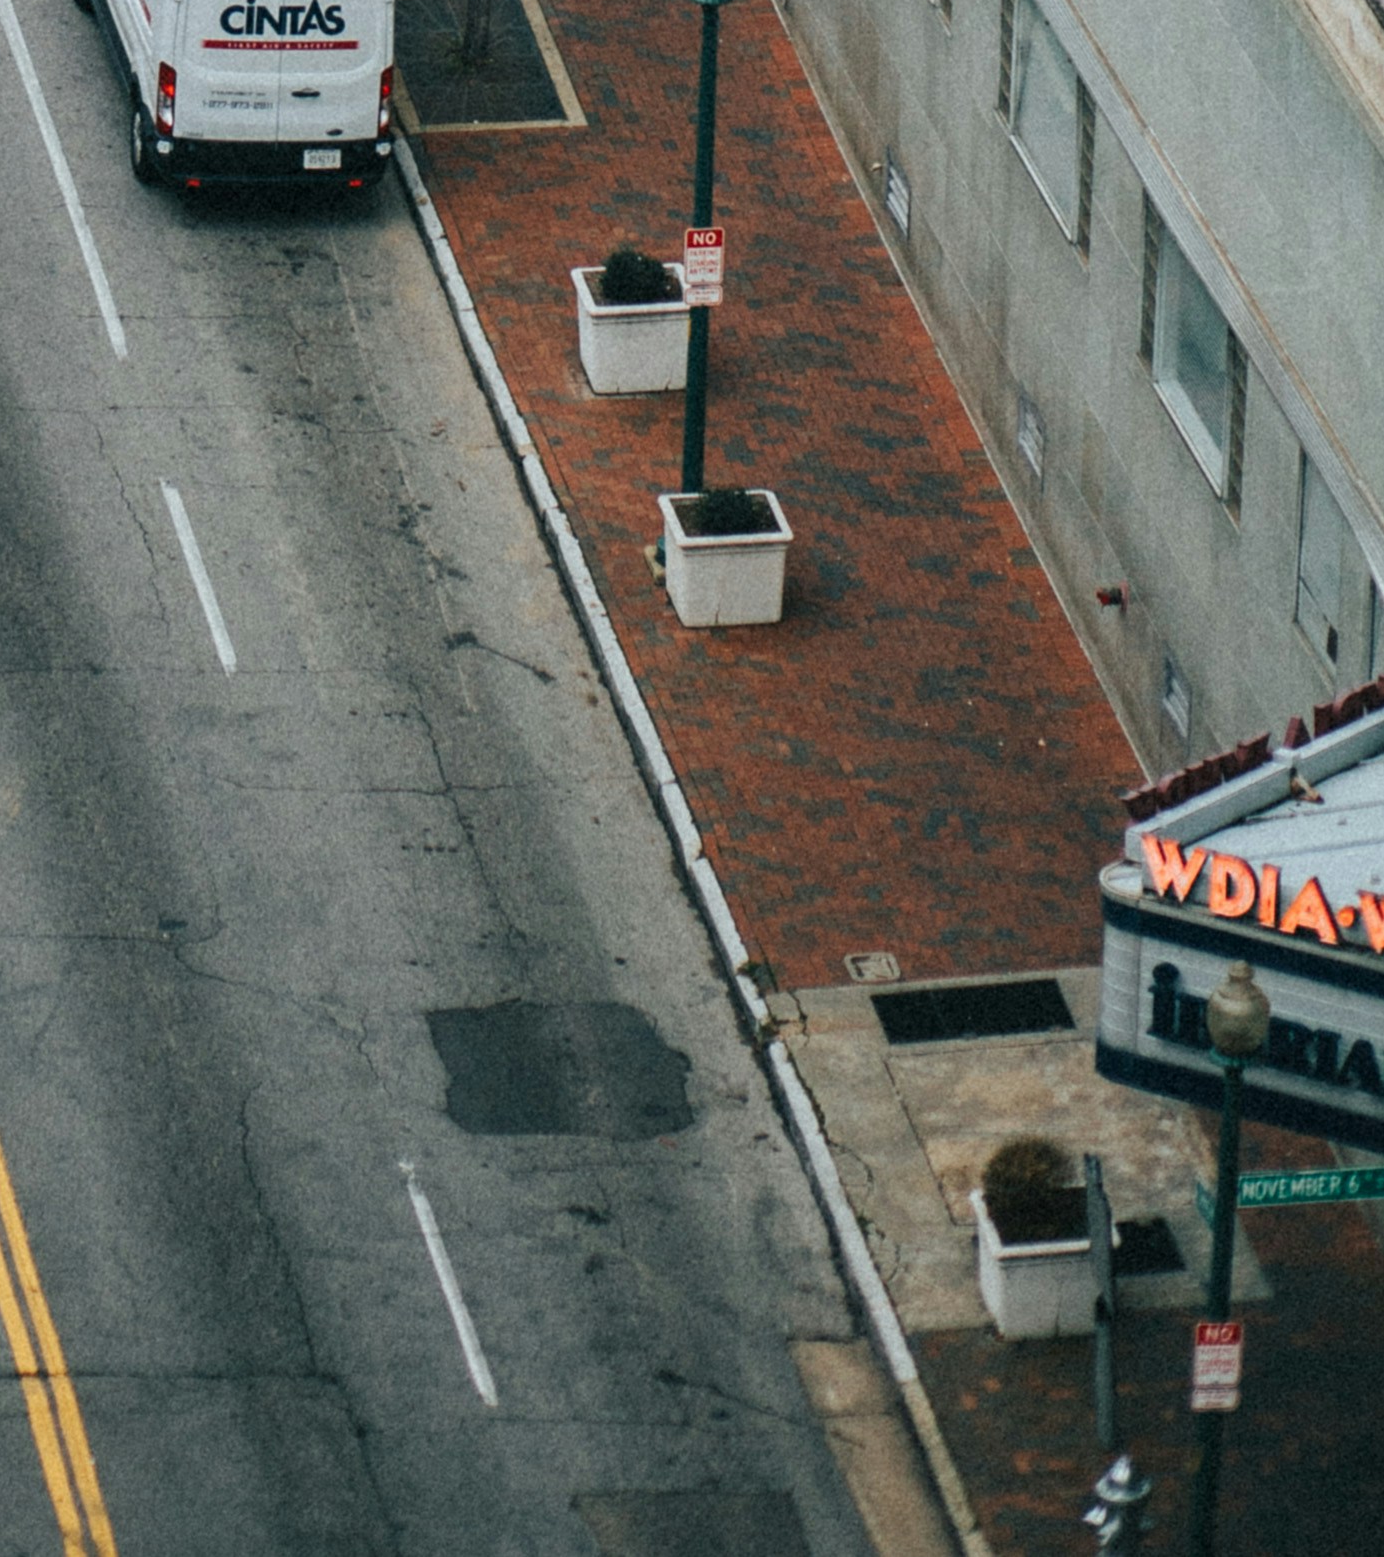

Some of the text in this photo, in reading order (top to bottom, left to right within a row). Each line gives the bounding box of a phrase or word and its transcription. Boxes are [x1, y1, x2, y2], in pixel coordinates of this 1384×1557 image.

[693, 232, 717, 246] NO
[1242, 1175, 1341, 1201] NOVEMBER
[1205, 1327, 1233, 1342] NO
